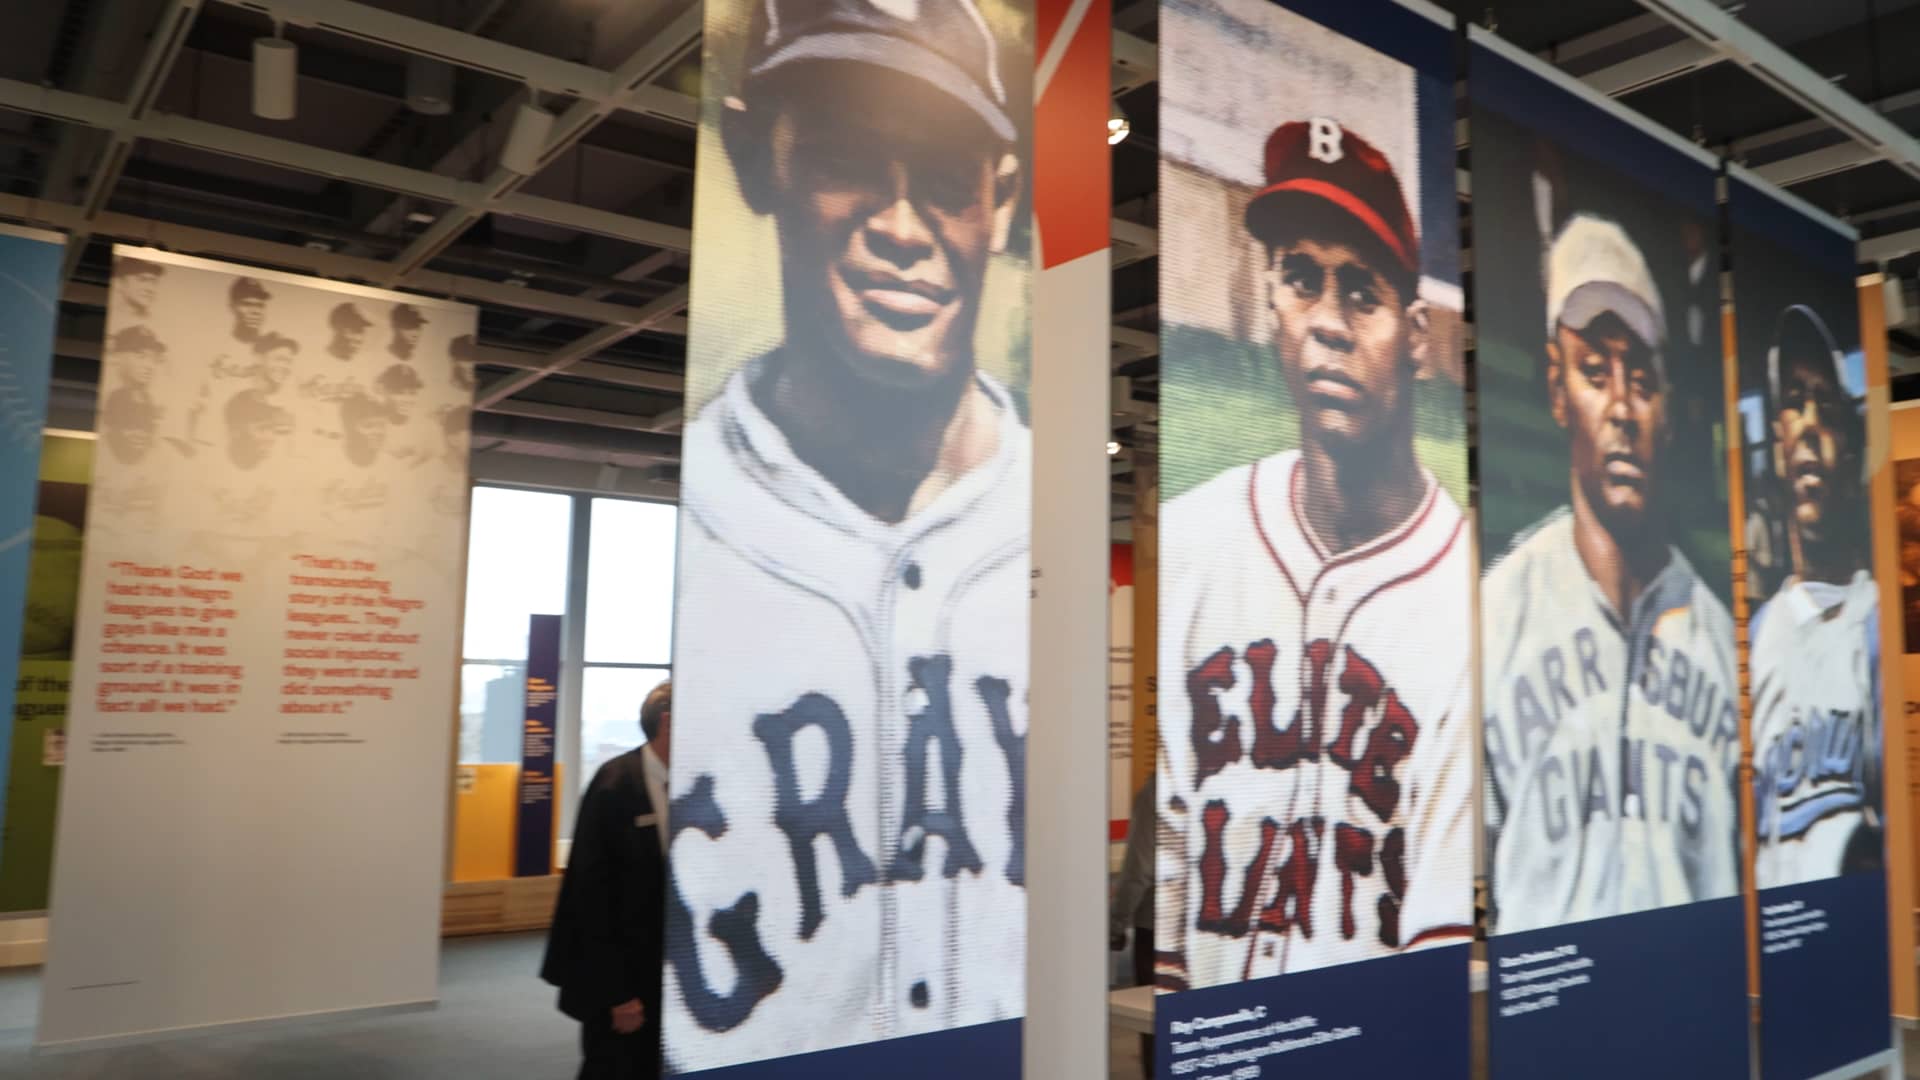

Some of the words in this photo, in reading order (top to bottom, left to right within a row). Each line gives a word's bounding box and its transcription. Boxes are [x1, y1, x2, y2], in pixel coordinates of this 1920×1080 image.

[1308, 117, 1345, 165] B
[350, 558, 377, 572] the
[178, 566, 215, 581] God
[218, 572, 244, 583] we
[105, 581, 141, 597] had
[142, 582, 175, 598] the
[177, 584, 233, 603] Negro
[104, 601, 176, 620] leagues
[178, 605, 197, 618] to
[199, 607, 239, 623] give
[331, 593, 348, 606] of
[351, 595, 376, 607] the
[378, 596, 425, 613] Negro
[363, 611, 400, 629] They
[103, 623, 147, 639] guys
[150, 621, 181, 636] like
[183, 625, 212, 637] me
[215, 627, 228, 638] a
[284, 630, 328, 641] never
[376, 631, 420, 645] about
[193, 645, 227, 657] was
[141, 660, 161, 674] of
[163, 663, 175, 674] a
[177, 663, 244, 680] training
[281, 665, 318, 681] they
[322, 667, 358, 678] went
[361, 668, 387, 679] out
[390, 667, 420, 680] and
[188, 683, 222, 695] was
[225, 682, 242, 694] in
[280, 682, 308, 696] did
[311, 684, 394, 701] something
[95, 697, 134, 713] fact
[137, 698, 158, 713] all
[163, 702, 186, 713] we
[278, 701, 326, 714] about
[1537, 735, 1710, 843] GIANTS
